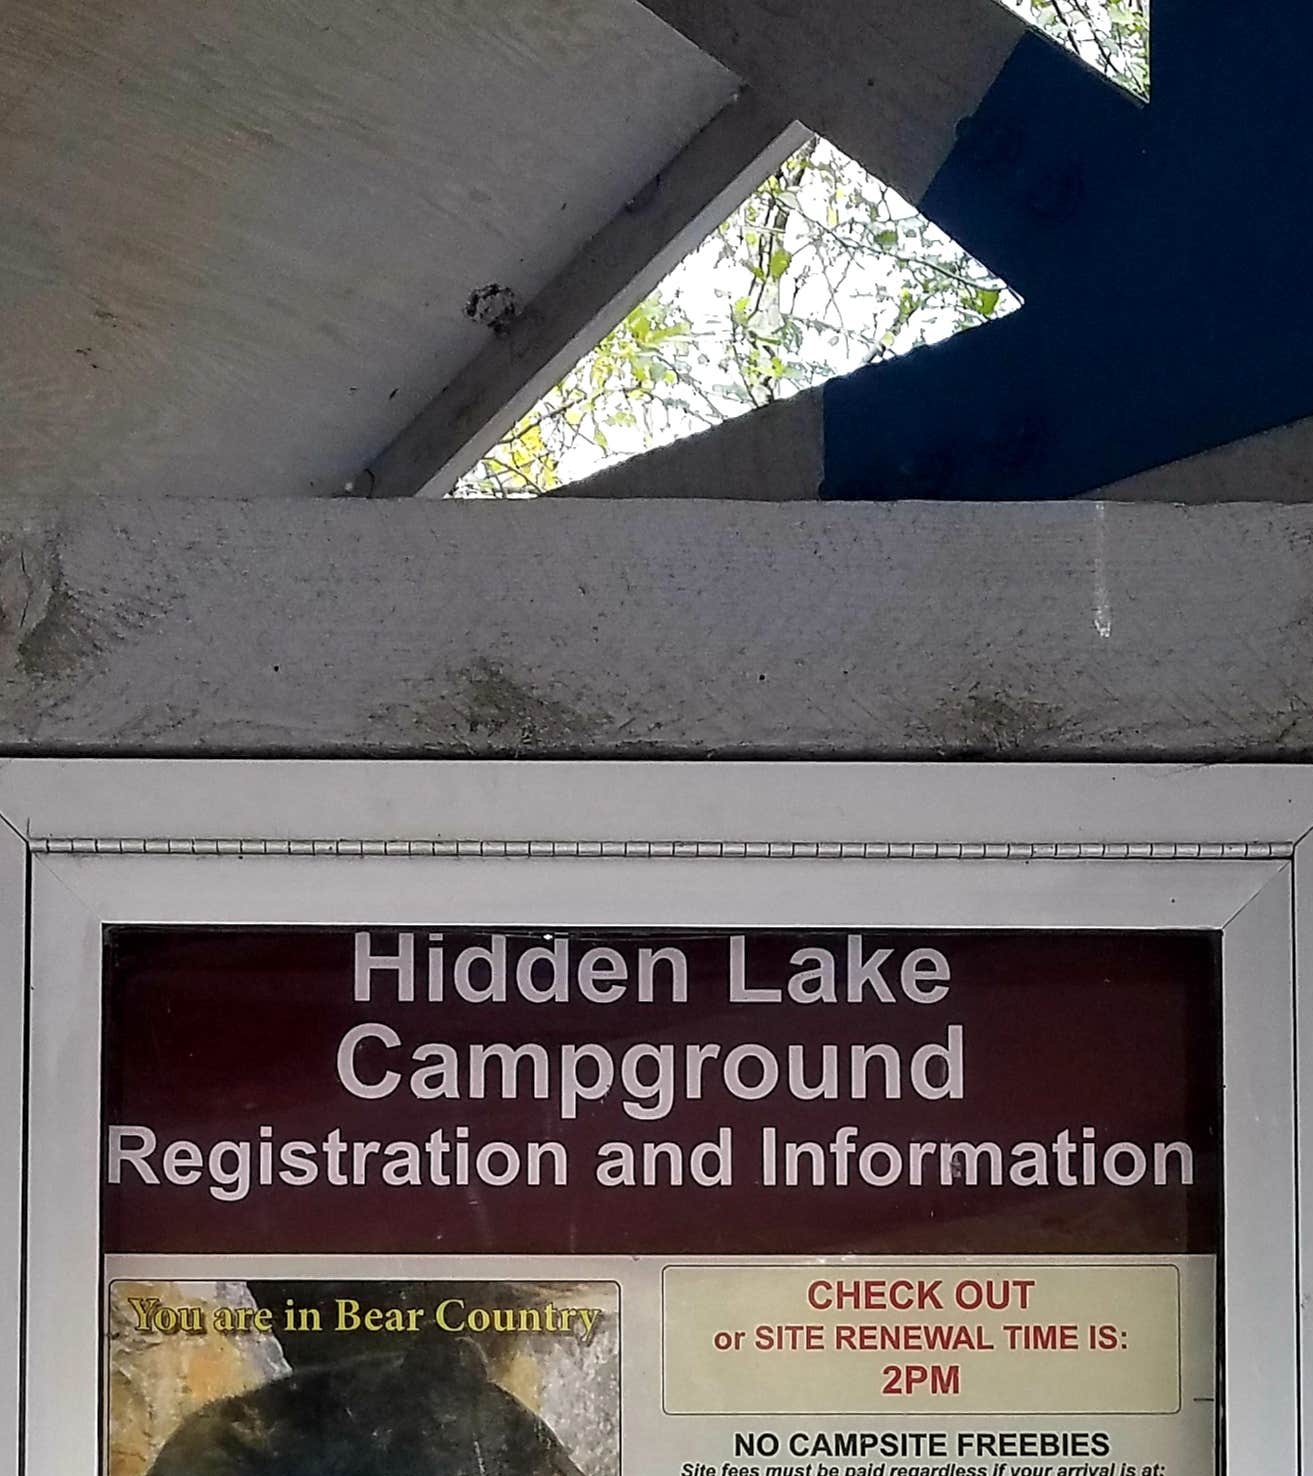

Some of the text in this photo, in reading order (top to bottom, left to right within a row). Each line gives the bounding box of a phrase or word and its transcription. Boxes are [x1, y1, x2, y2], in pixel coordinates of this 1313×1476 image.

[353, 931, 952, 1004] Hidden Lake
[337, 1022, 964, 1121] Campground
[108, 1125, 1193, 1190] Registration and Information
[808, 1279, 1036, 1310] CHECK OUT
[127, 1298, 602, 1342] You are in Bear Country
[714, 1324, 1128, 1351] or SITE RENEWAL TIME IS:
[882, 1365, 960, 1395] 2PM
[735, 1432, 1110, 1457] NO CAMPSITE FREEBIES
